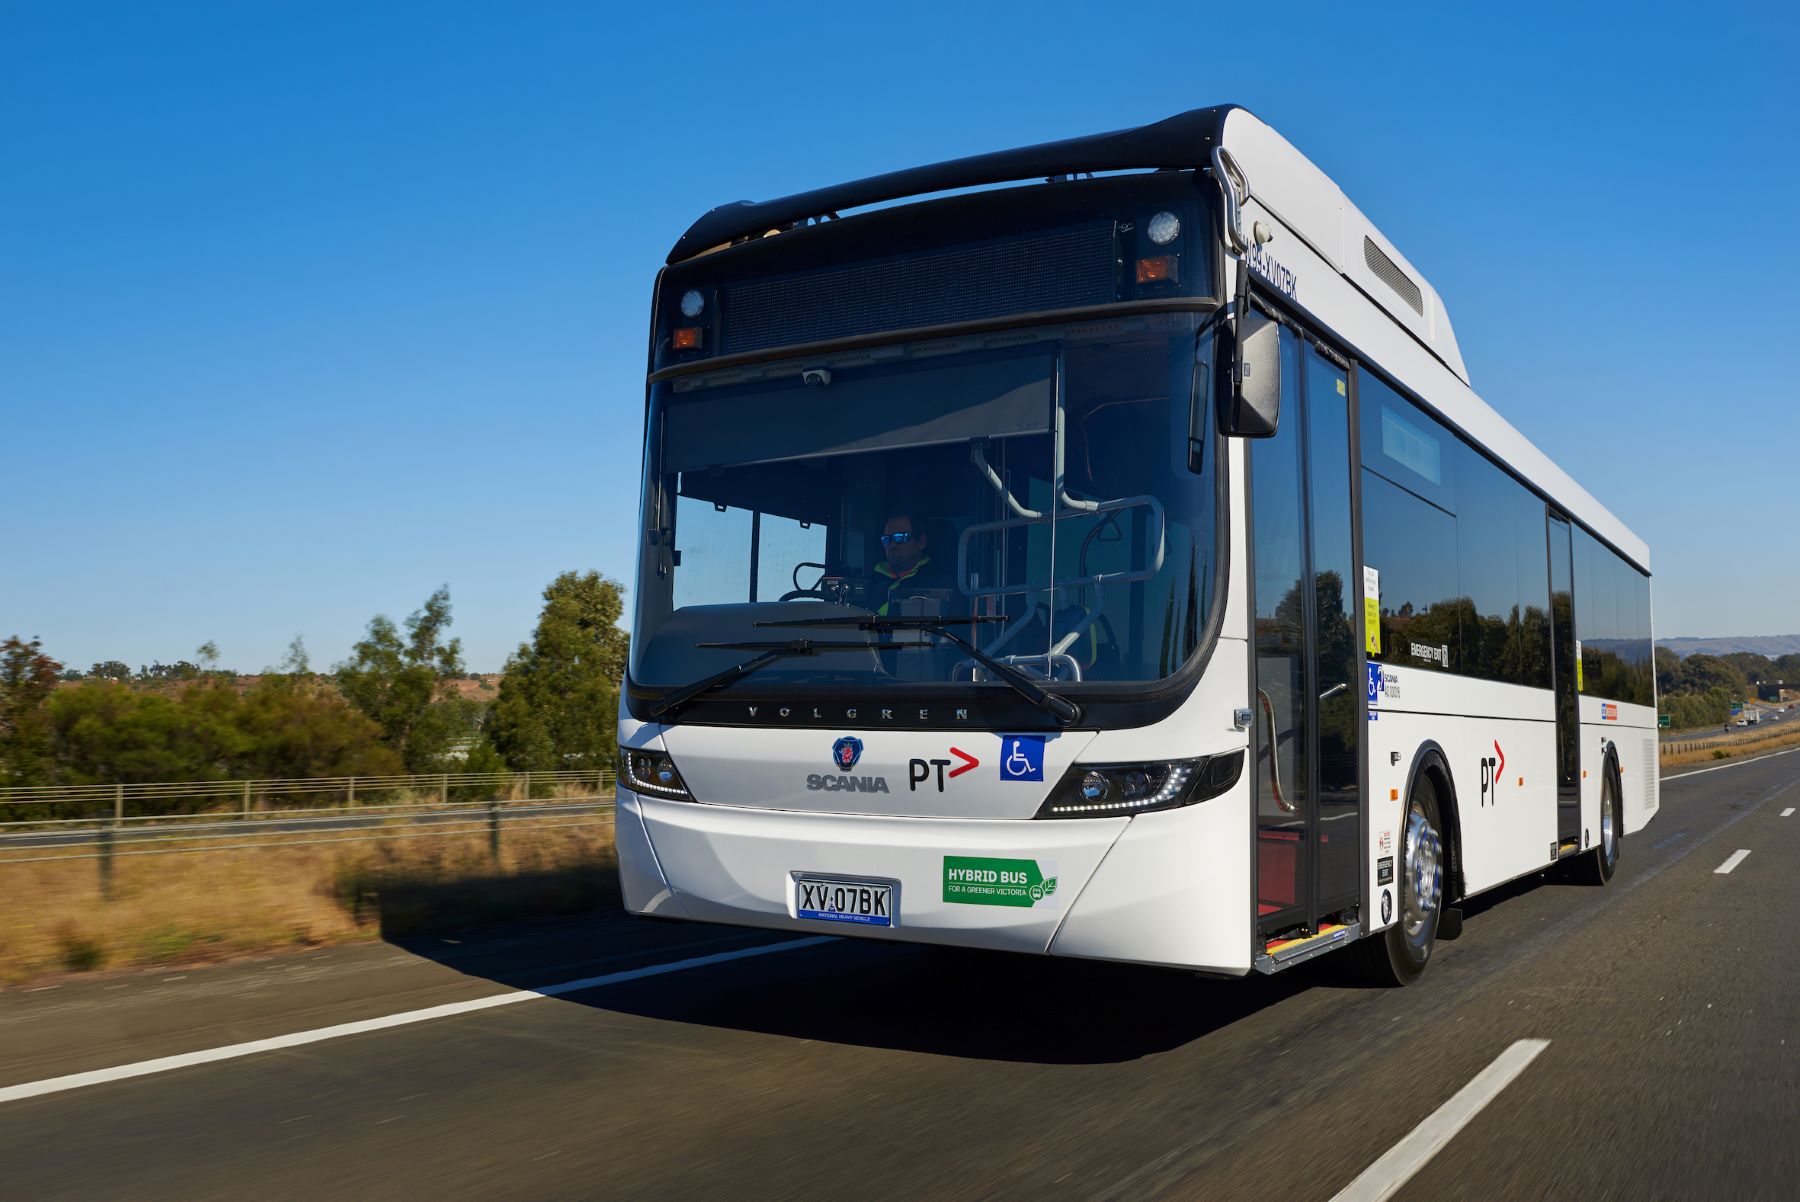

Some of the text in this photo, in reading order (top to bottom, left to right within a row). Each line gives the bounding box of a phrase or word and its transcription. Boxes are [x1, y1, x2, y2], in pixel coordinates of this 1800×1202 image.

[749, 706, 968, 720] VOLGREN
[806, 773, 890, 794] SCANIA
[948, 868, 1028, 884] HYBRID BUS
[948, 885, 961, 893] FOR
[967, 886, 995, 895] GREENER
[996, 888, 1027, 896] VICTORIA
